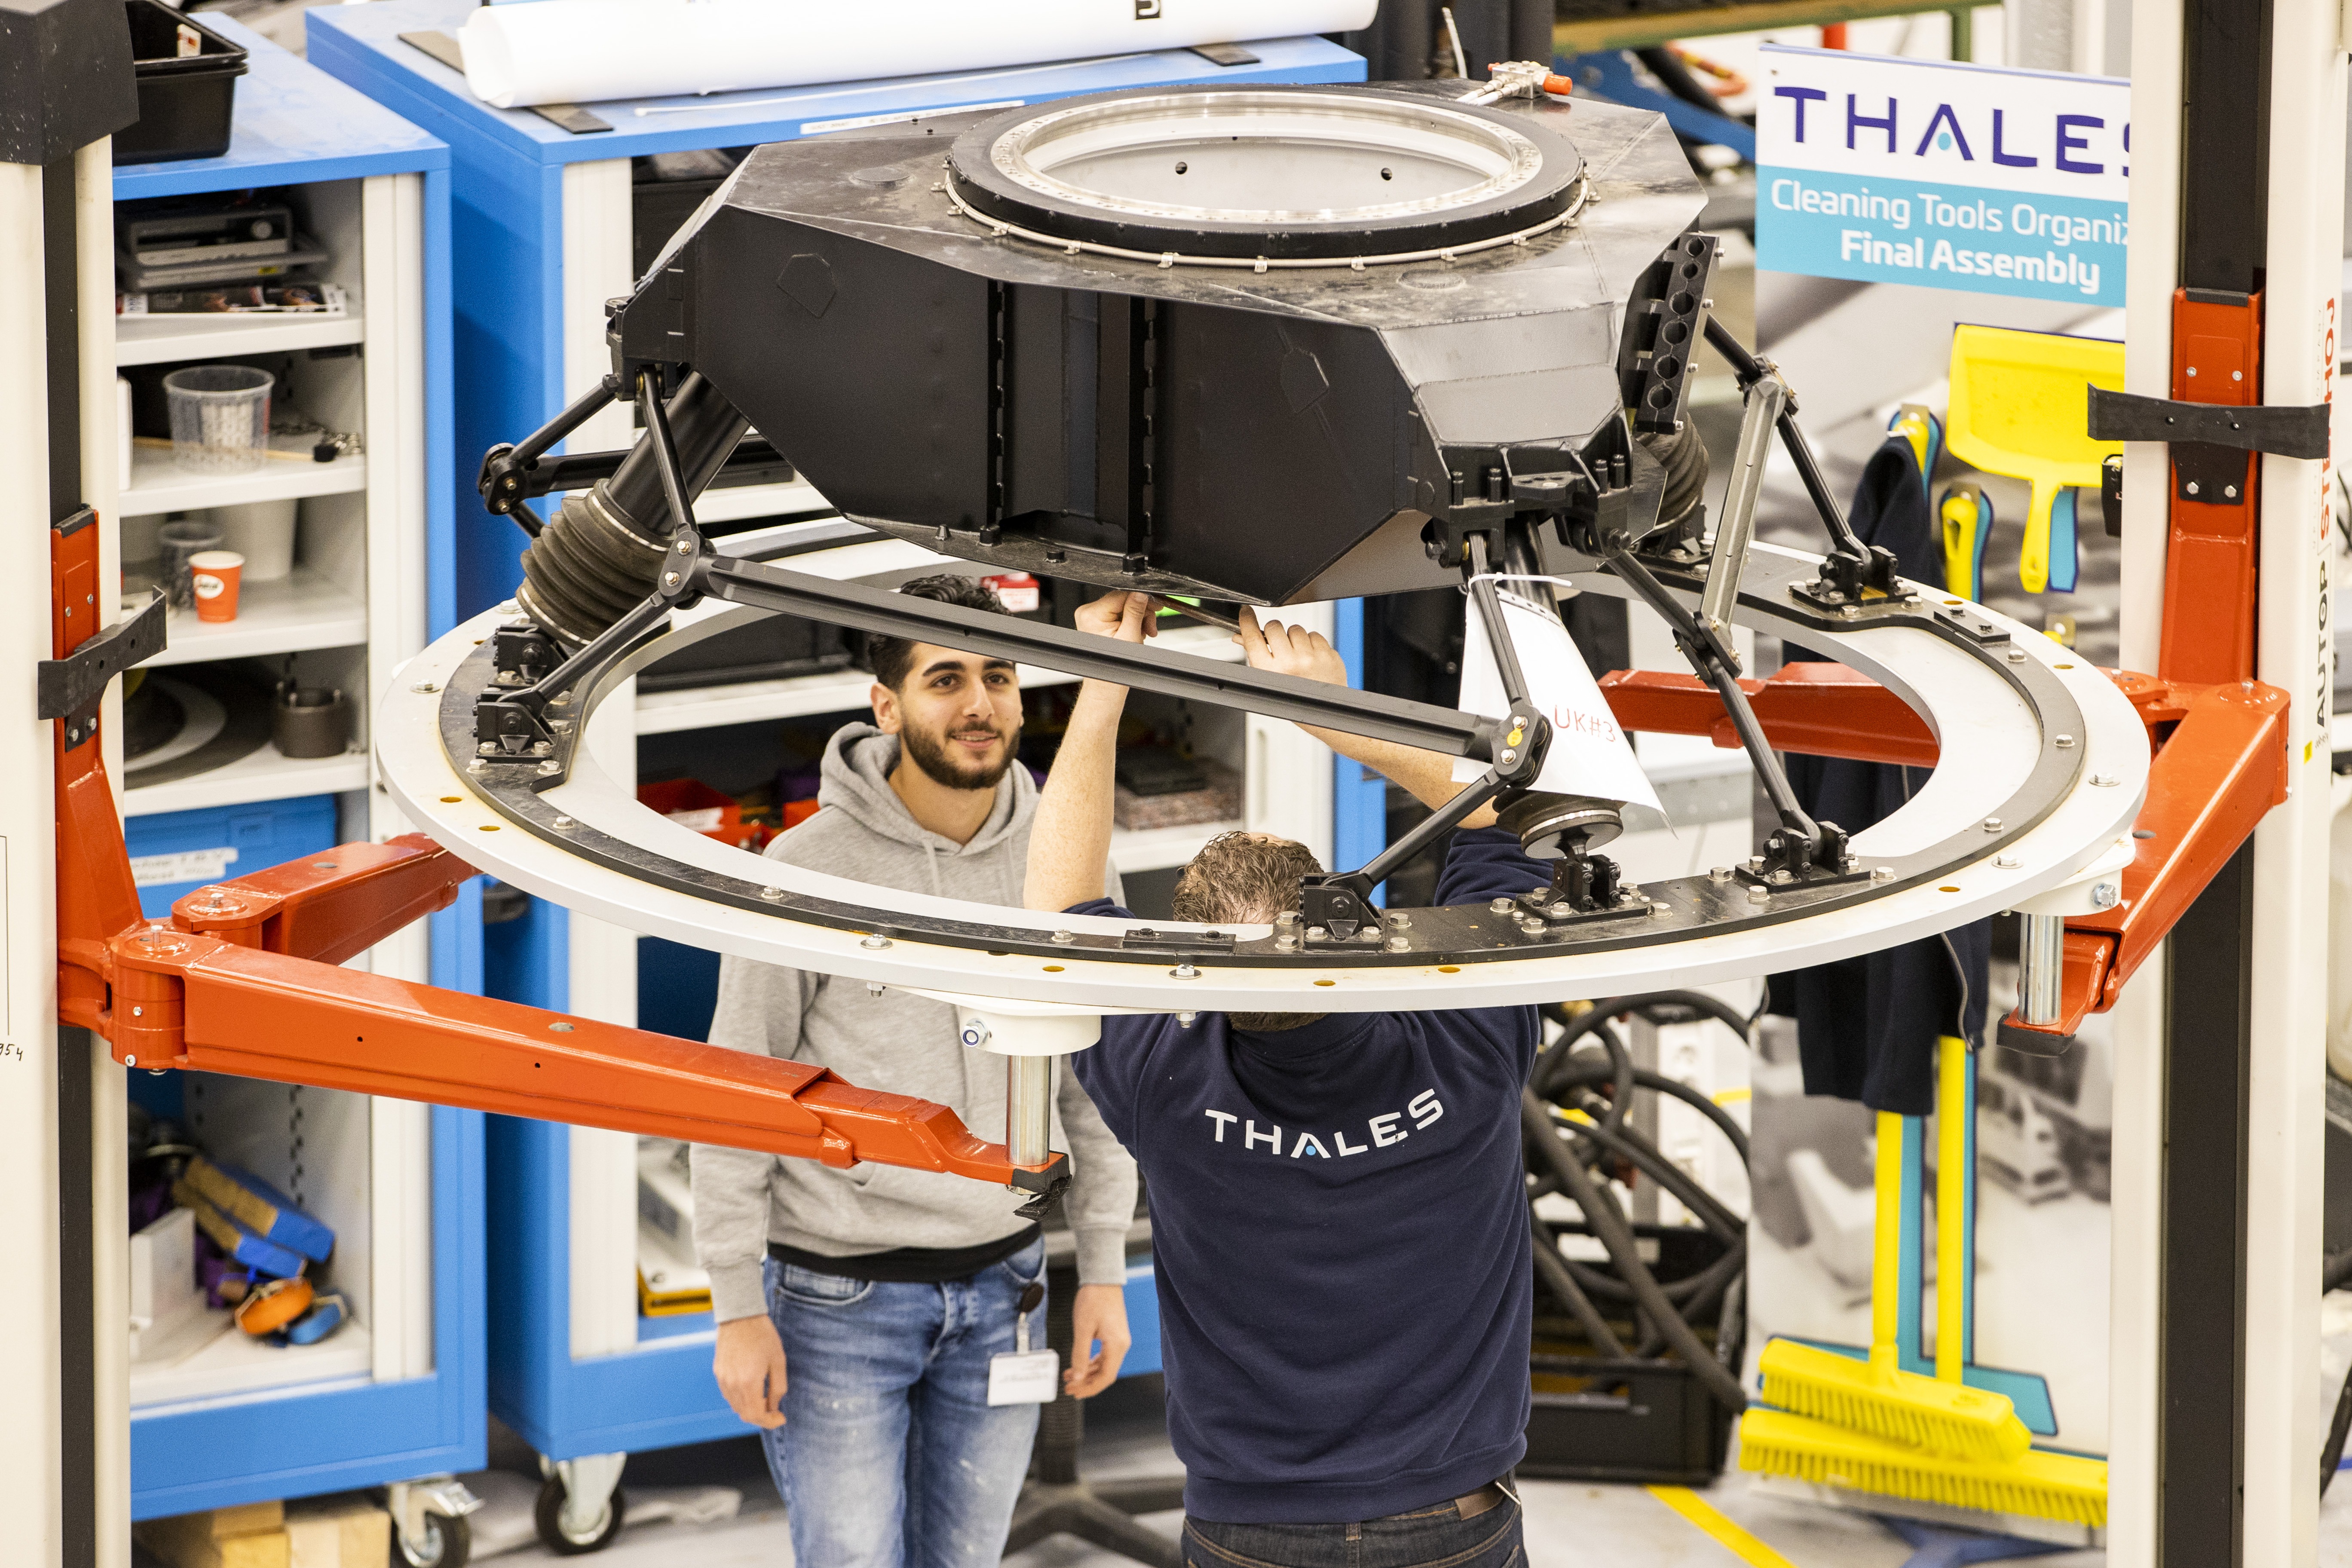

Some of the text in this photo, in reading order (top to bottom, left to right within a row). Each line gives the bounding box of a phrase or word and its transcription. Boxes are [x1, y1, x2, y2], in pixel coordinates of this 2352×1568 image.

[1774, 86, 2129, 177] THALE
[1771, 178, 1911, 229] Cleaning
[1917, 193, 2003, 232] Tools
[1841, 229, 2100, 295] Final Assembly
[1554, 704, 1616, 742] UK#3
[1205, 1088, 1443, 1158] THALES
